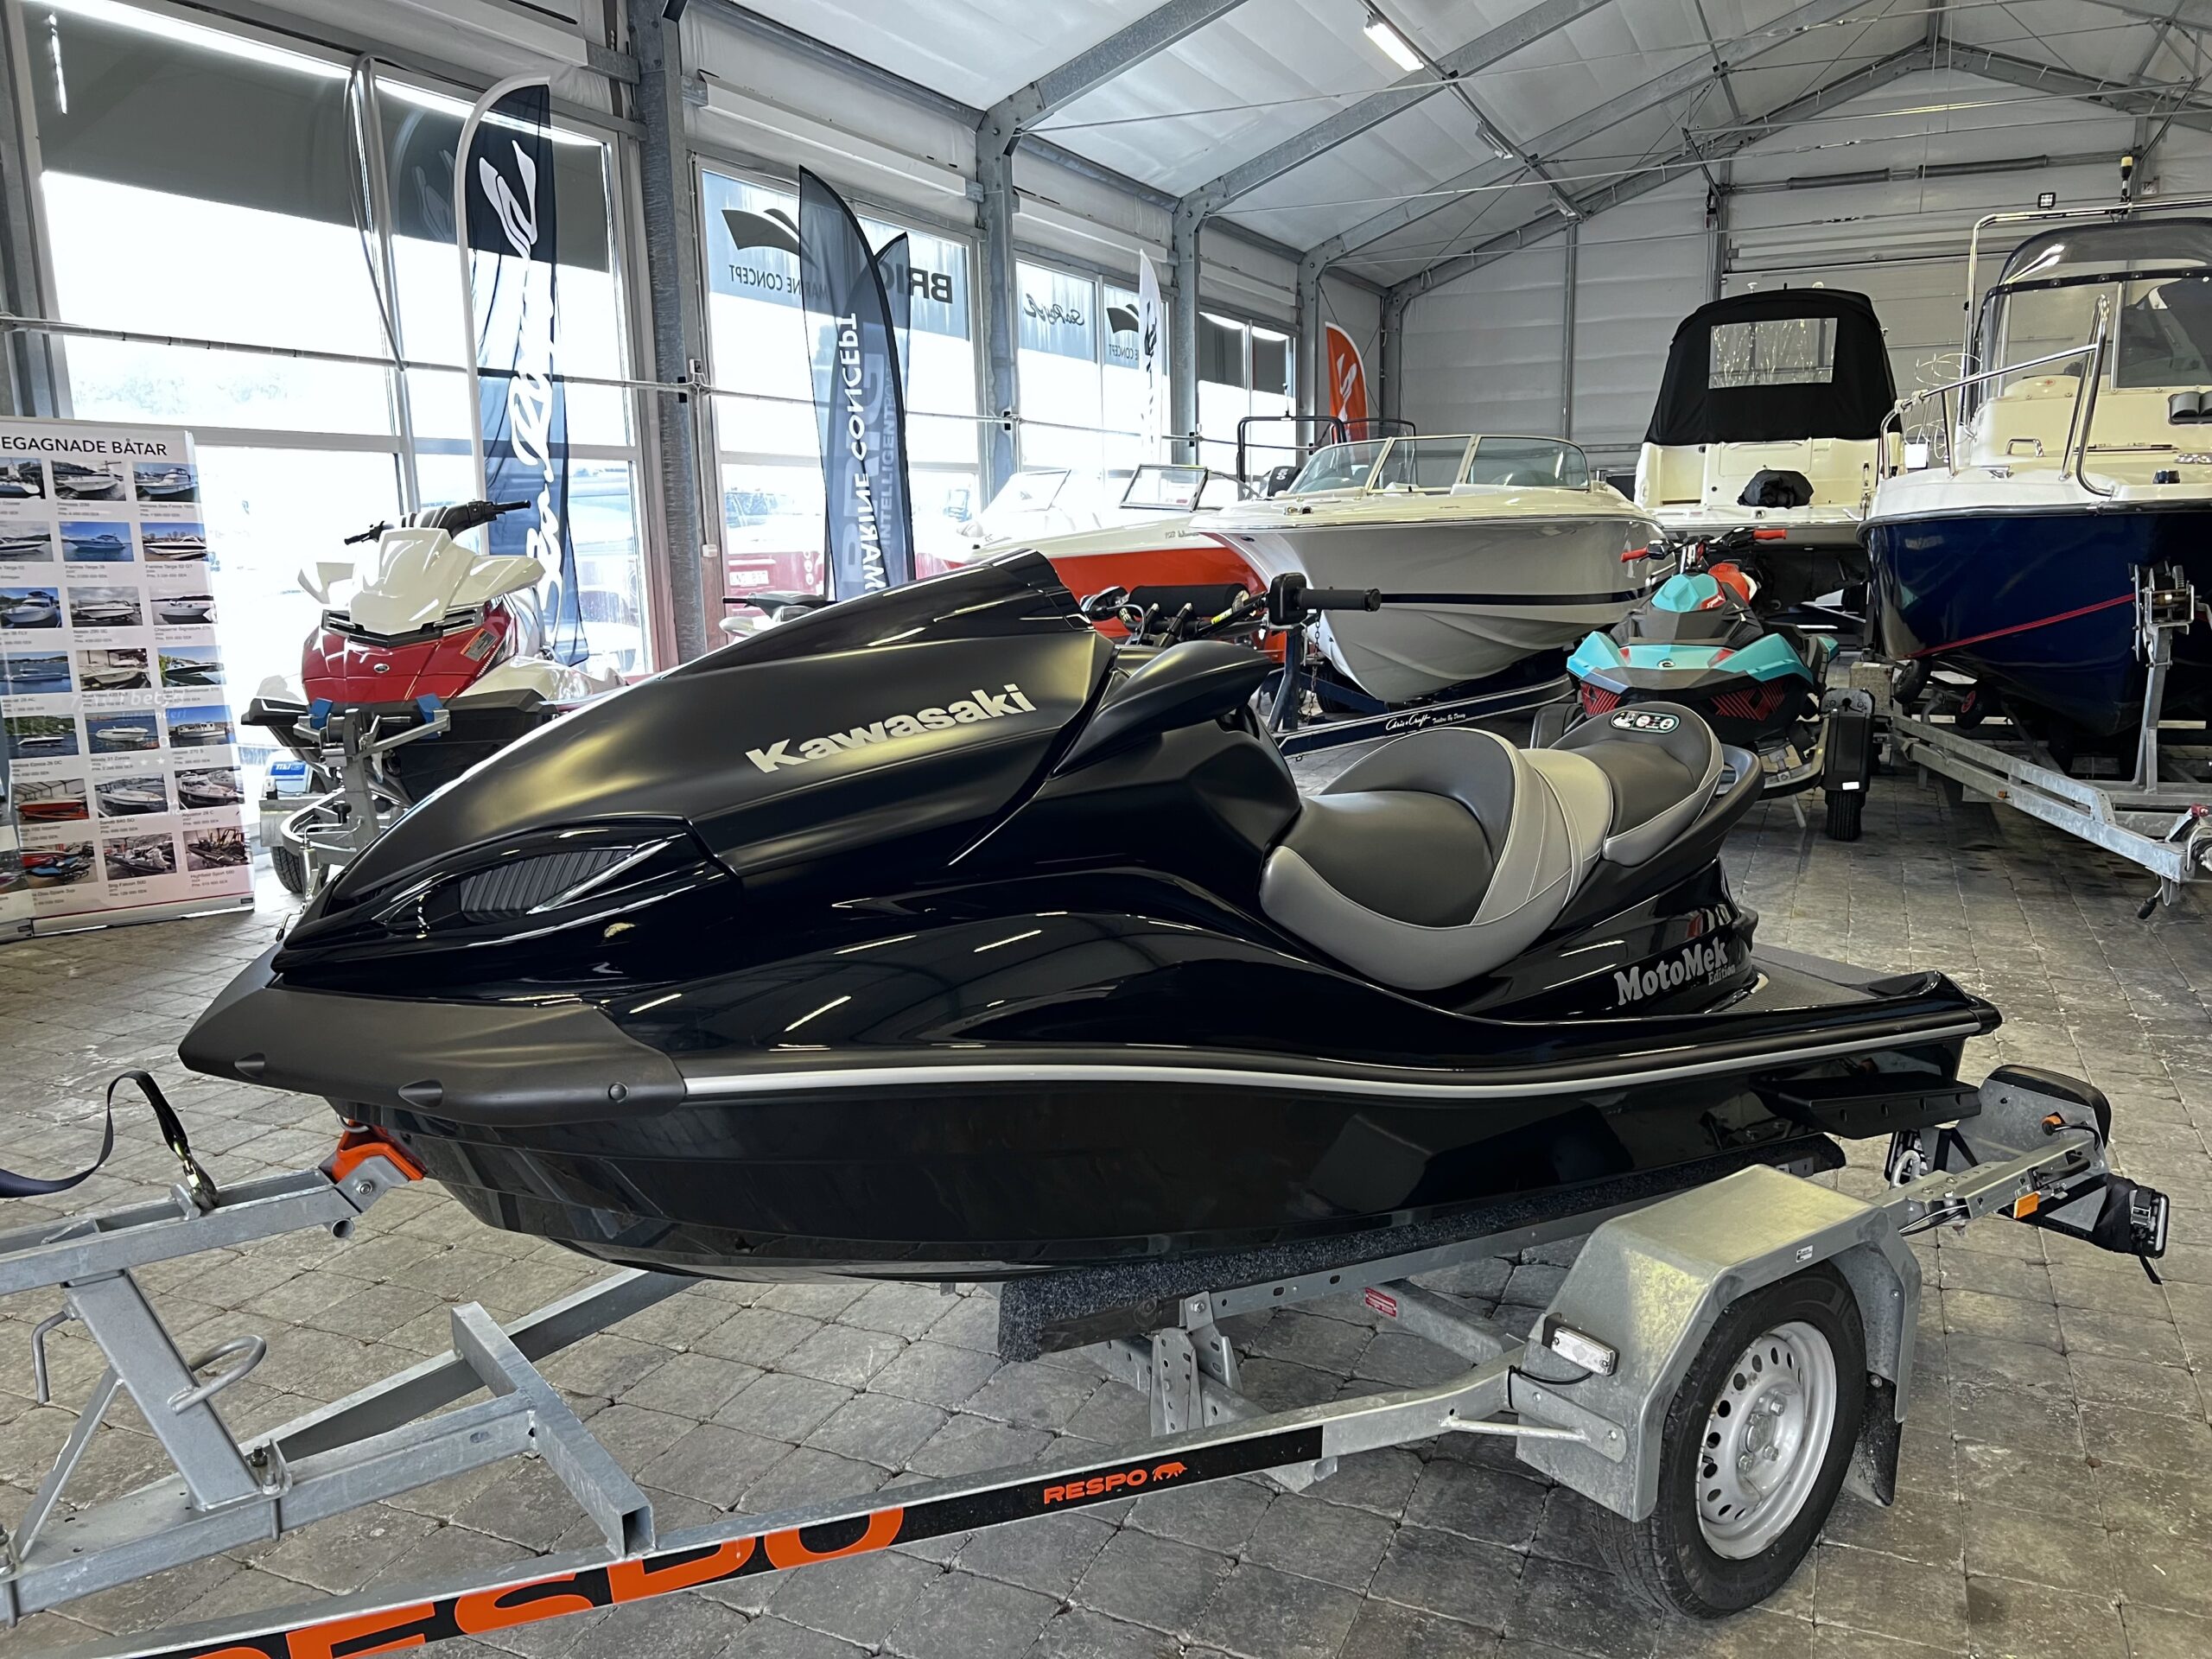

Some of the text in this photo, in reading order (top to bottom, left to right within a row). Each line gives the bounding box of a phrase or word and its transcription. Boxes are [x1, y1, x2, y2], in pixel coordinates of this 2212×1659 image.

[0, 436, 168, 456] EGAGNADE BÅTAR
[745, 683, 1036, 773] Kawasaki
[1614, 937, 1728, 1005] MotoMek
[1708, 964, 1736, 986] Edition
[1044, 1469, 1147, 1505] RESPO
